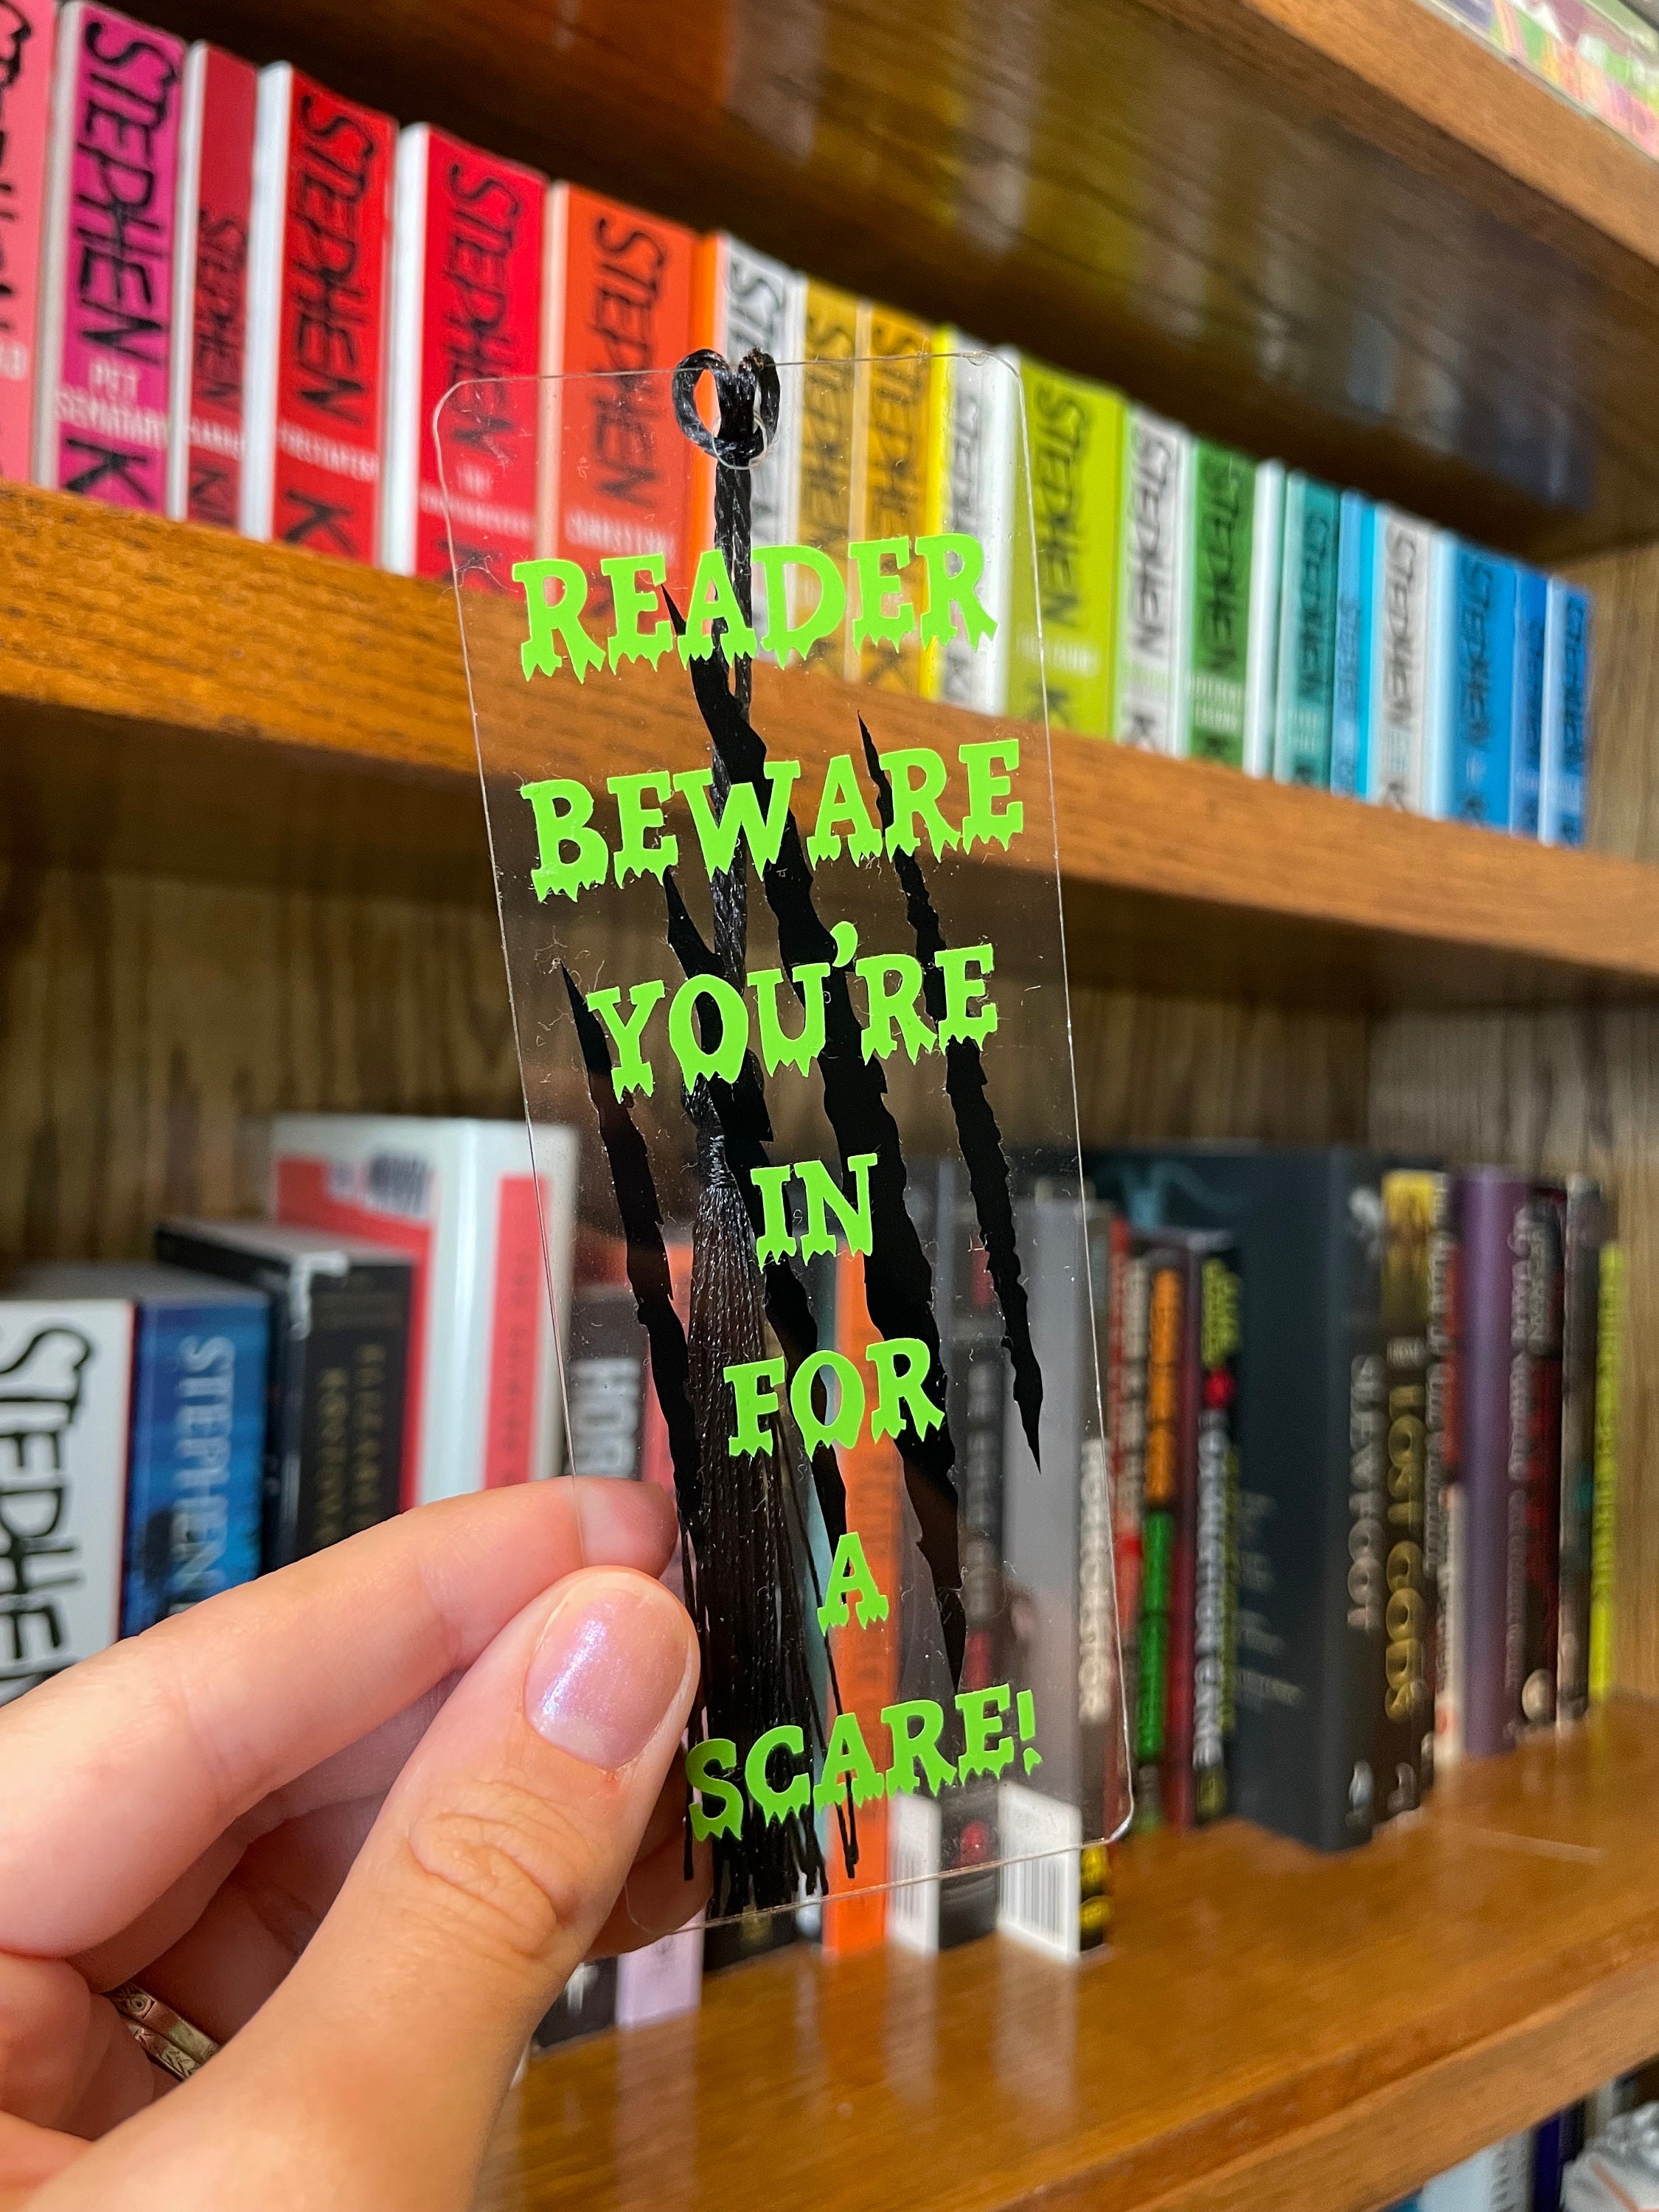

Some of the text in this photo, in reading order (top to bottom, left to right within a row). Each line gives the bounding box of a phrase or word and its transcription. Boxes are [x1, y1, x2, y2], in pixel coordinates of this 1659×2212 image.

[77, 21, 178, 366] STEPHEN
[295, 94, 375, 426] STEPHEN
[193, 208, 246, 407] STEPHEN
[444, 164, 521, 462] STEPHEN
[588, 215, 668, 509] STEPHEN
[514, 532, 997, 681] READER
[1032, 378, 1093, 628] STEPHEN
[1134, 437, 1172, 658] STEPHEN
[1194, 463, 1241, 672] STEPHEN
[1384, 526, 1416, 731] STEPHEN
[522, 740, 1023, 900] BEWARE
[588, 923, 998, 1097] YOU'RE
[751, 1155, 877, 1265] IN
[168, 1336, 237, 1593] STEPHEN
[725, 1339, 944, 1461] FOR
[818, 1533, 889, 1635] A
[1385, 1385, 1426, 1722] LOST GODS
[684, 1684, 1043, 1840] SCARE!
